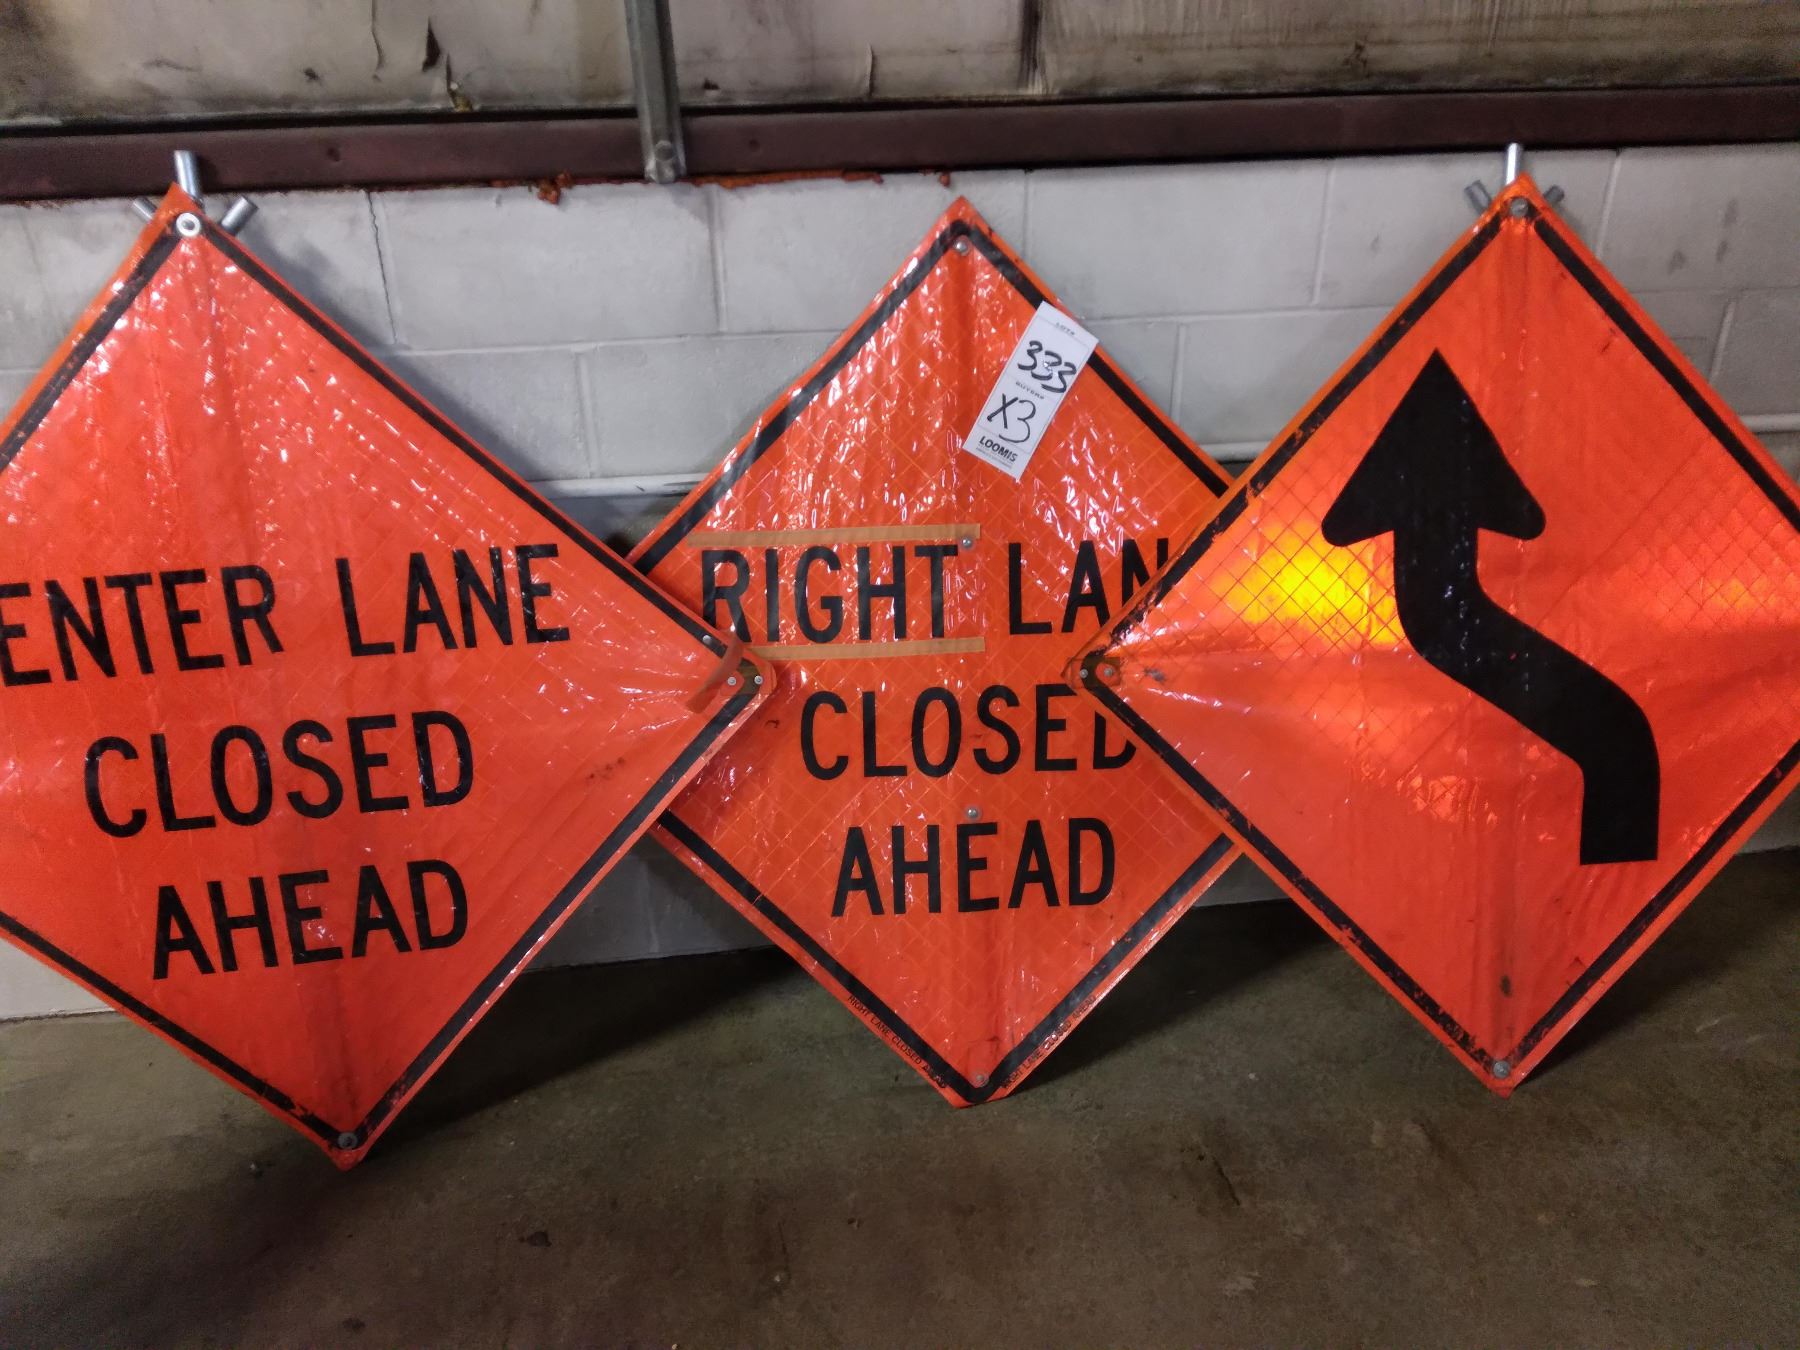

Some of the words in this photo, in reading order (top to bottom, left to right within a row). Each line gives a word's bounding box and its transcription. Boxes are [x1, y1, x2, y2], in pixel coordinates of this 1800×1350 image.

[1017, 340, 1077, 394] 333
[979, 435, 1018, 462] LOOMIS
[987, 393, 1036, 443] X3
[0, 565, 283, 687] ENTER
[335, 543, 571, 657] LANE
[702, 545, 959, 643] RIGHT
[84, 710, 474, 838] CLOSED
[801, 683, 1137, 780] CLOSED
[831, 817, 1116, 917] AHEAD
[153, 859, 469, 980] AHEAD
[848, 995, 869, 1017] RIGHT
[870, 1015, 891, 1037] LANE
[892, 1035, 922, 1065] CLOSED
